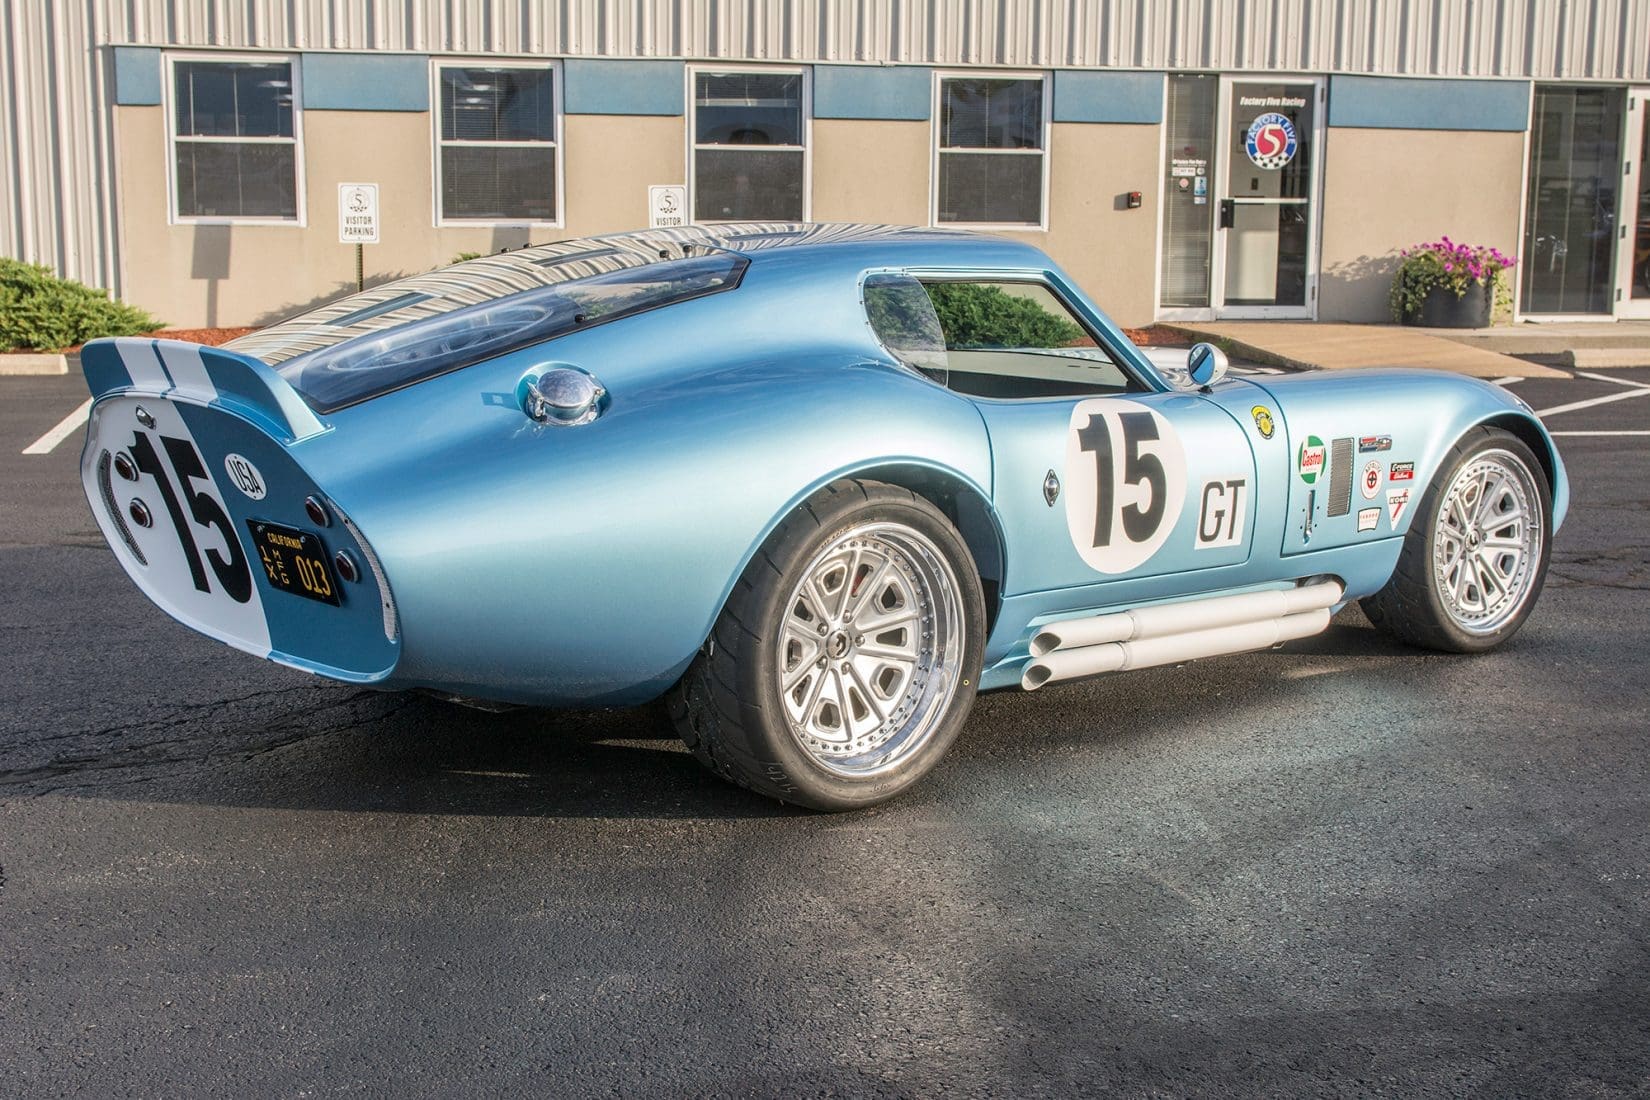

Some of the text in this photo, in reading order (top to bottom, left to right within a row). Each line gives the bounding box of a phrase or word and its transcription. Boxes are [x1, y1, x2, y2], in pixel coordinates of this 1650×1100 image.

[1240, 97, 1306, 108] Factory Five Racing
[1247, 115, 1296, 144] FACTORY FIVE
[1262, 124, 1282, 157] 5
[344, 226, 374, 236] PARKING
[345, 216, 372, 225] VISITOR
[656, 217, 682, 226] VISITOR
[1302, 448, 1324, 467] Castrol
[228, 459, 264, 495] USA
[1076, 411, 1167, 548] 15
[127, 430, 252, 603] 15
[1199, 479, 1246, 542] GT
[267, 533, 303, 550] CALIFORNIA
[296, 555, 331, 596] 013
